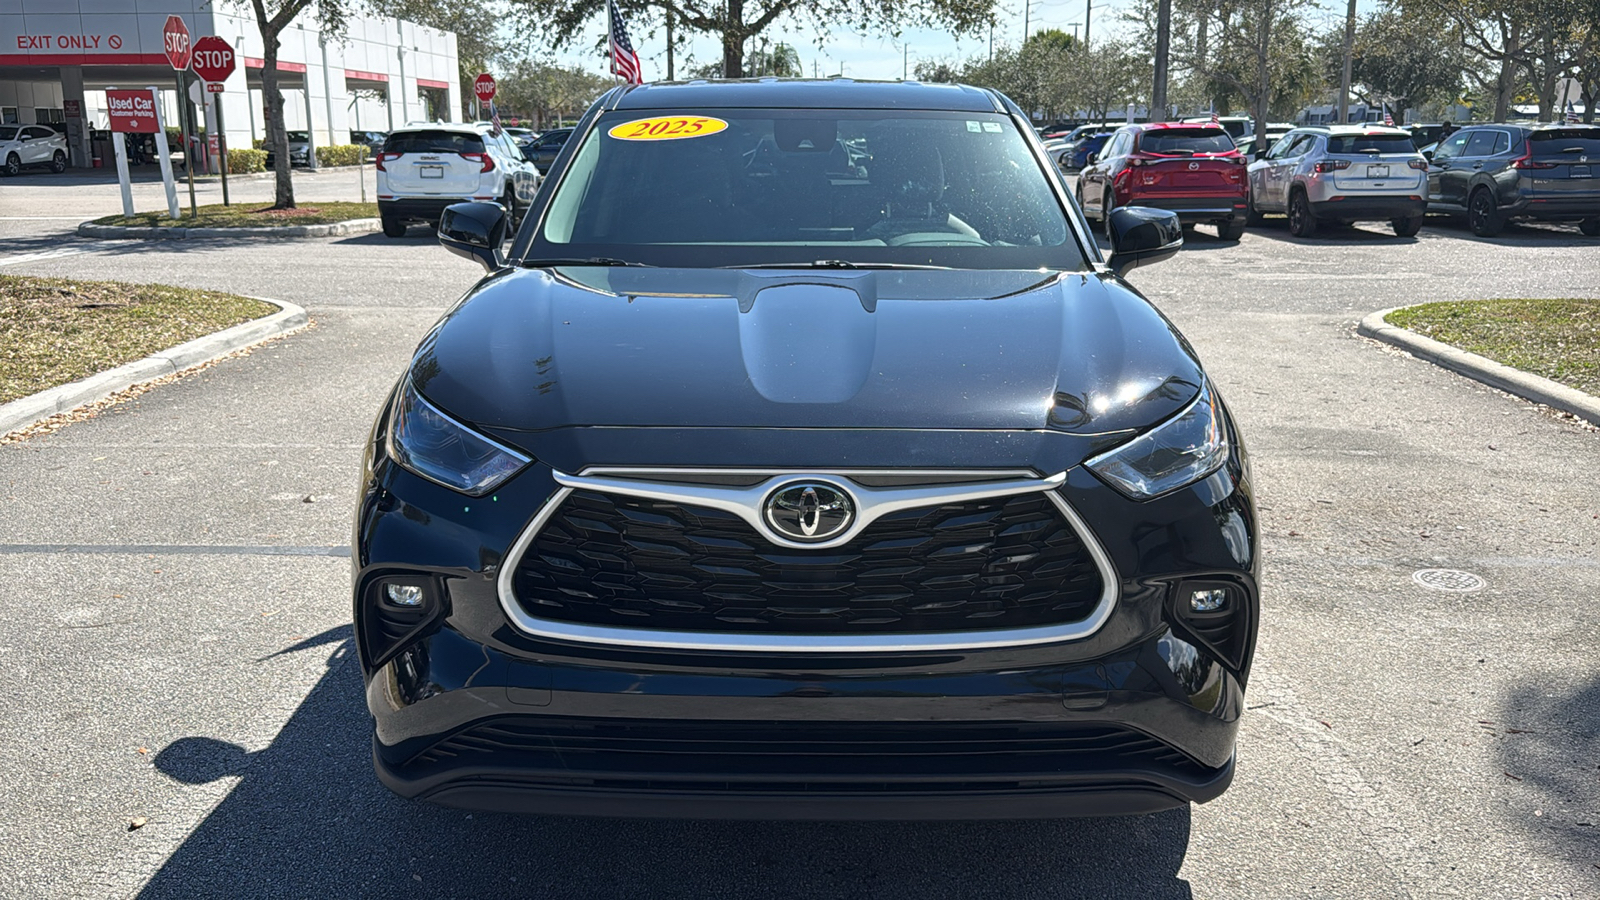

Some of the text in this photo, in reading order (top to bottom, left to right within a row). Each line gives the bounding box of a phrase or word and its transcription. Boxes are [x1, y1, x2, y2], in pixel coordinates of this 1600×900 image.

[17, 34, 101, 49] EXIT ONLY
[165, 31, 189, 53] STOP
[194, 50, 232, 69] STOP
[476, 82, 495, 94] STOP
[108, 97, 152, 110] Used Car
[134, 110, 154, 118] Parking
[627, 119, 708, 137] 2025
